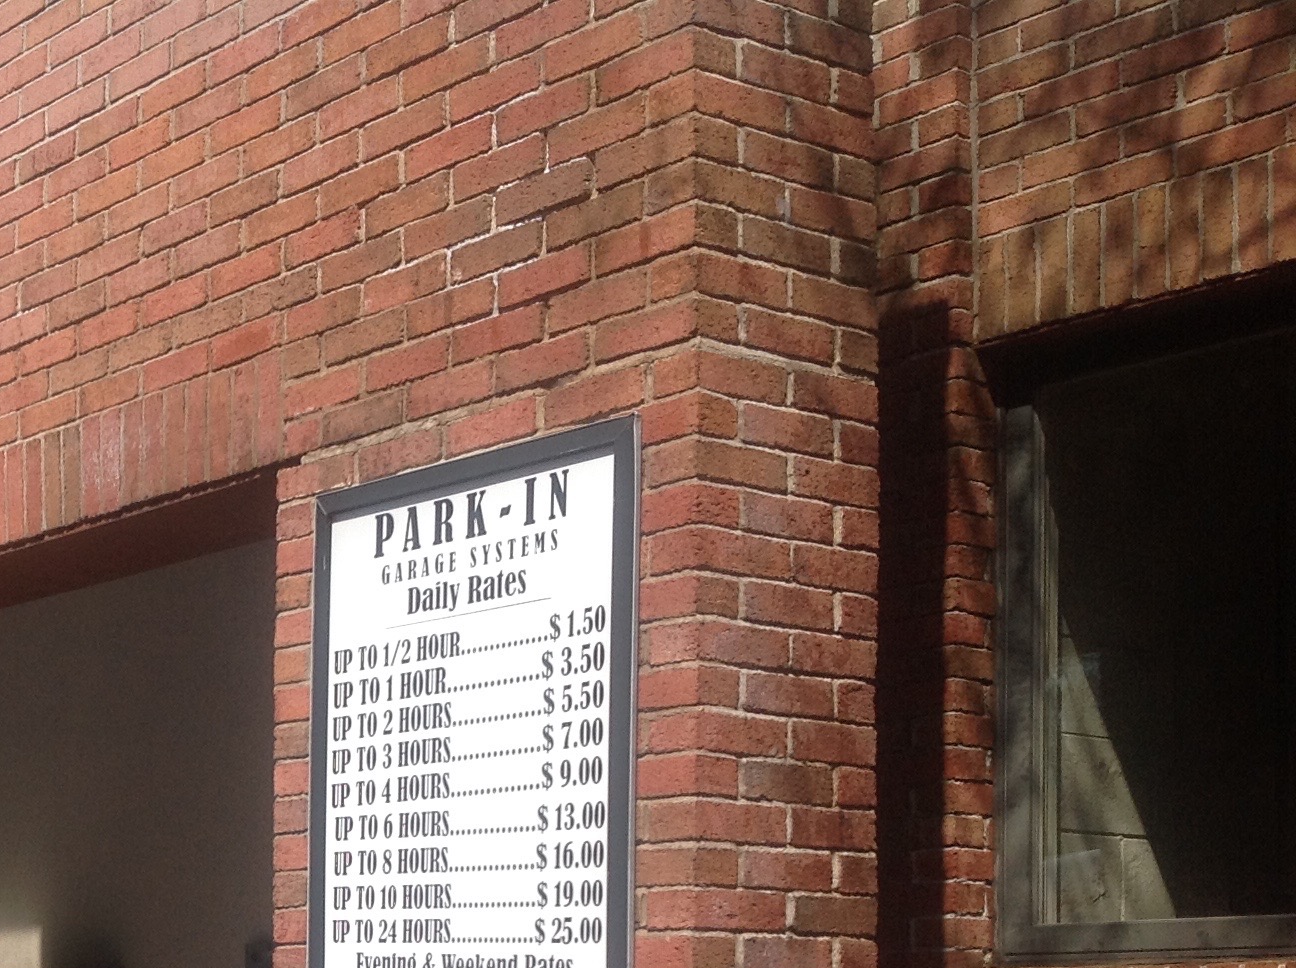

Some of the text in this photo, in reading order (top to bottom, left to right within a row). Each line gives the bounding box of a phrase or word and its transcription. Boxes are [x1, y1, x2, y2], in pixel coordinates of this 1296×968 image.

[374, 469, 569, 558] PARK-IN
[382, 529, 557, 585] GARAGE SYSTEMS
[407, 570, 526, 615] Daily Rates
[334, 649, 353, 675] UP
[359, 644, 377, 670] TO
[384, 639, 411, 667] 1/2
[334, 681, 353, 709] UP
[359, 677, 380, 705] TO
[387, 675, 392, 701] 1
[333, 716, 352, 742] UP
[358, 712, 377, 738] TO
[383, 710, 393, 735] 2
[332, 749, 351, 775] UP
[357, 745, 376, 772] TO
[383, 743, 392, 769] 3
[332, 783, 350, 808] UP
[356, 780, 376, 806] TO
[382, 778, 391, 803] 4
[335, 816, 353, 841] UP
[359, 814, 378, 840] TO
[384, 814, 393, 839] 6
[334, 851, 352, 876] UP
[358, 850, 377, 875] TO
[382, 849, 392, 874] 8
[333, 886, 351, 910] UP
[356, 885, 375, 910] TO
[381, 885, 397, 909] 10
[333, 920, 350, 943] UP
[355, 919, 373, 943] TO
[379, 919, 397, 943] 24
